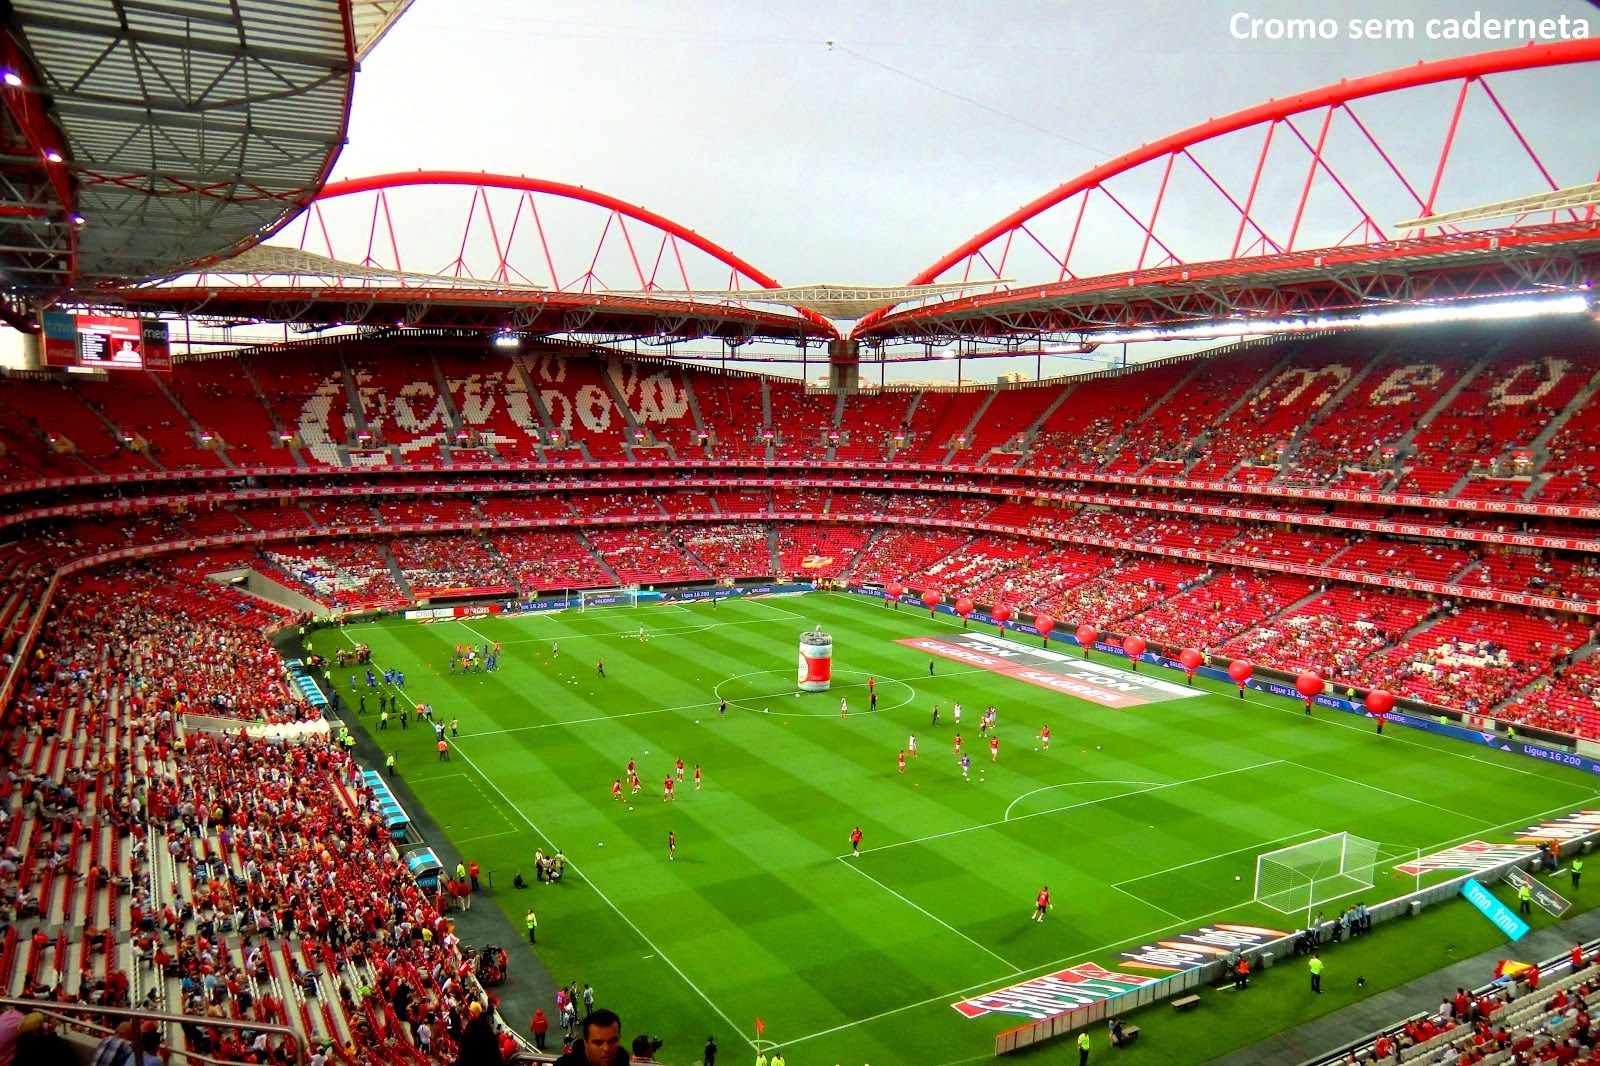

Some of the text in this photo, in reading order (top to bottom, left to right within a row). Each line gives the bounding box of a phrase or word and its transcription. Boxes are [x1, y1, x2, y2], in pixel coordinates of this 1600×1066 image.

[144, 328, 167, 339] meo
[1249, 356, 1574, 408] meo
[1246, 485, 1262, 493] meo
[1286, 488, 1304, 496] meo
[1330, 491, 1348, 499] meo
[1353, 493, 1372, 501] meo
[1377, 495, 1396, 503] meo
[1402, 496, 1422, 505] meo
[1428, 498, 1449, 507] meo
[1455, 500, 1477, 509] meo
[1484, 502, 1506, 511] meo
[1514, 504, 1538, 513] meo
[1545, 506, 1570, 515] meo
[1155, 502, 1169, 510] meo
[1207, 507, 1222, 515] meo
[1226, 509, 1241, 517] meo
[1245, 511, 1260, 519] meo
[1265, 513, 1281, 521] meo
[1285, 515, 1302, 523] meo
[1306, 517, 1324, 525] meo
[1328, 519, 1346, 527] meo
[1351, 521, 1370, 529] meo
[1375, 523, 1394, 532] meo
[1400, 525, 1420, 534] meo
[1426, 528, 1447, 537] meo
[1453, 530, 1475, 539] meo
[1481, 533, 1504, 542] meo
[1511, 535, 1534, 545] meo
[1542, 538, 1566, 548] meo
[1575, 541, 1600, 551] meo
[1134, 544, 1148, 552] meo
[1151, 546, 1165, 554] meo
[1186, 551, 1201, 559] meo
[1338, 571, 1356, 581] meo
[1362, 574, 1381, 584] meo
[1387, 578, 1408, 588] meo
[1414, 581, 1434, 591] meo
[1441, 585, 1463, 595] meo
[1470, 589, 1493, 599] meo
[1500, 593, 1524, 604] meo
[1530, 597, 1555, 608] meo
[1561, 601, 1587, 612] meo
[914, 641, 1000, 665] SAGRES
[955, 641, 1021, 657] ZON
[1017, 671, 1124, 701] SAGRES
[1065, 671, 1143, 692] ZON
[1270, 684, 1286, 697] Ligue
[1287, 687, 1296, 697] 16
[1317, 697, 1340, 708] meo.pt
[1524, 745, 1581, 766] Ligue 16 200
[418, 878, 435, 887] tmn
[1469, 885, 1519, 934] tmn tmn
